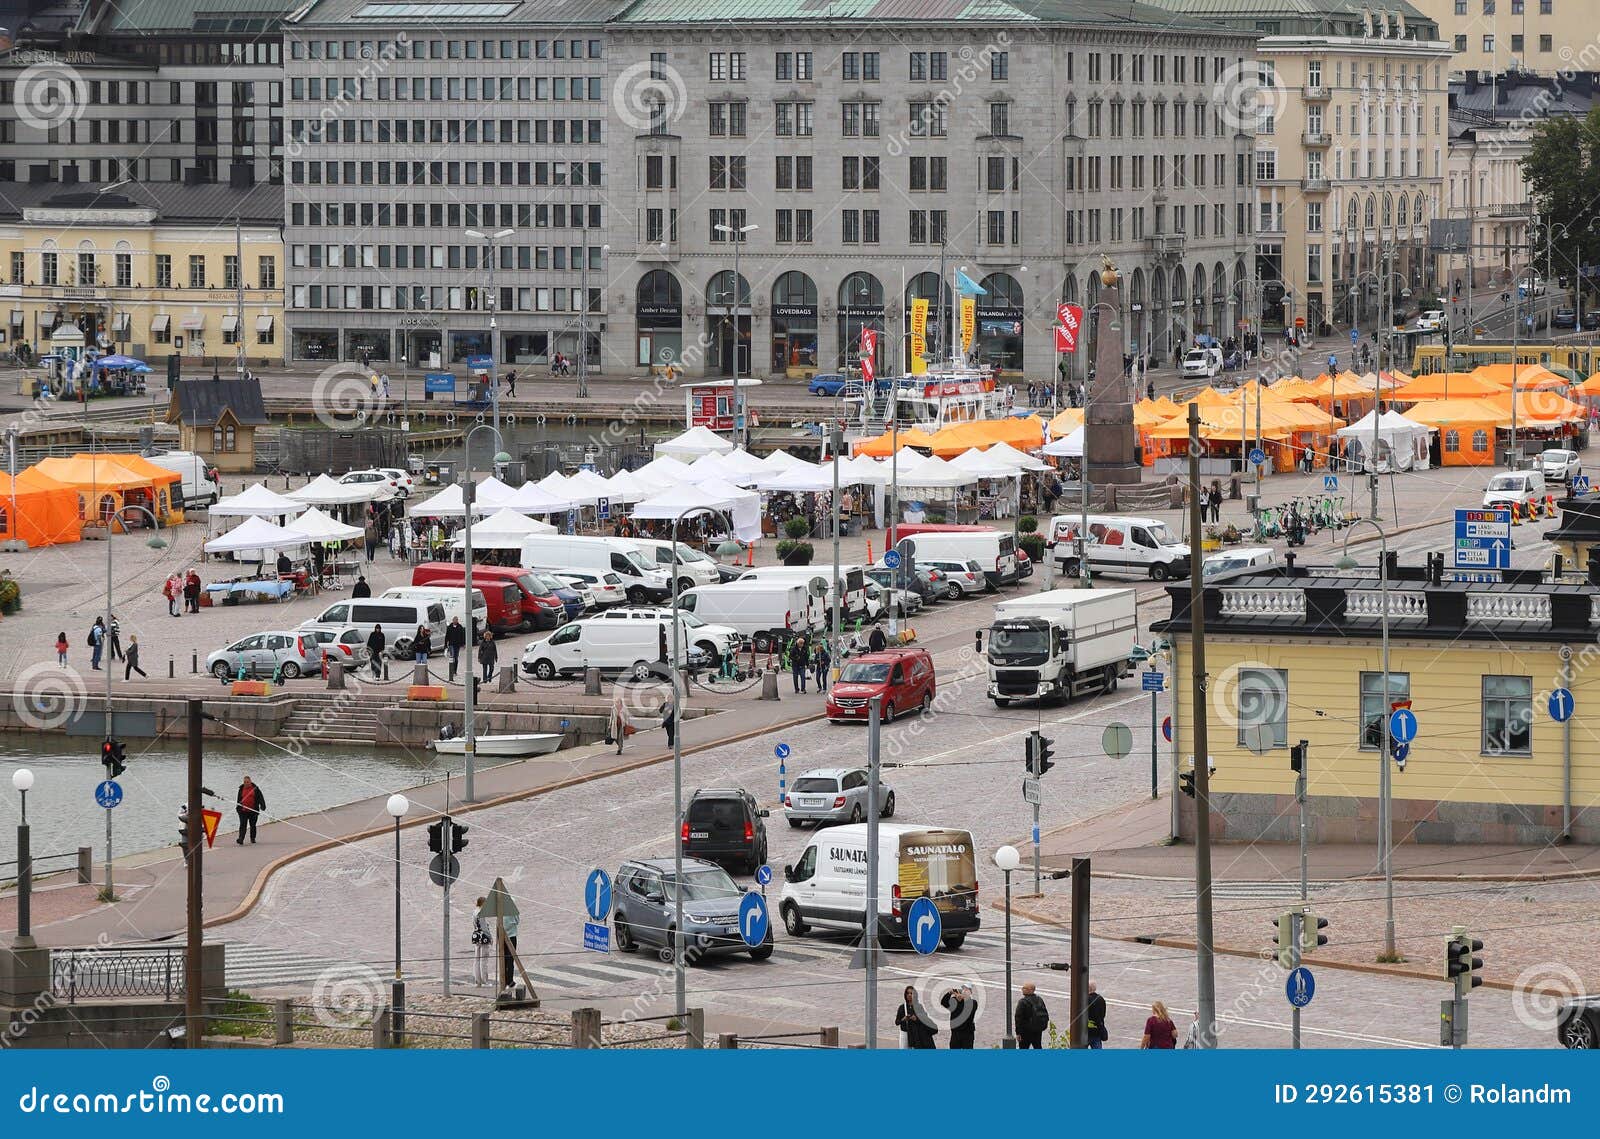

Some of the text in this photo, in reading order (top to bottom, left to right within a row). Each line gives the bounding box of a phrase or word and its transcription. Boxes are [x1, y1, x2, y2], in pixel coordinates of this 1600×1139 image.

[915, 304, 925, 357] SIGHTSEEING
[964, 304, 973, 351] SIGHTSEE
[830, 847, 867, 863] SAUNATA
[907, 844, 966, 856] SAUNATALO
